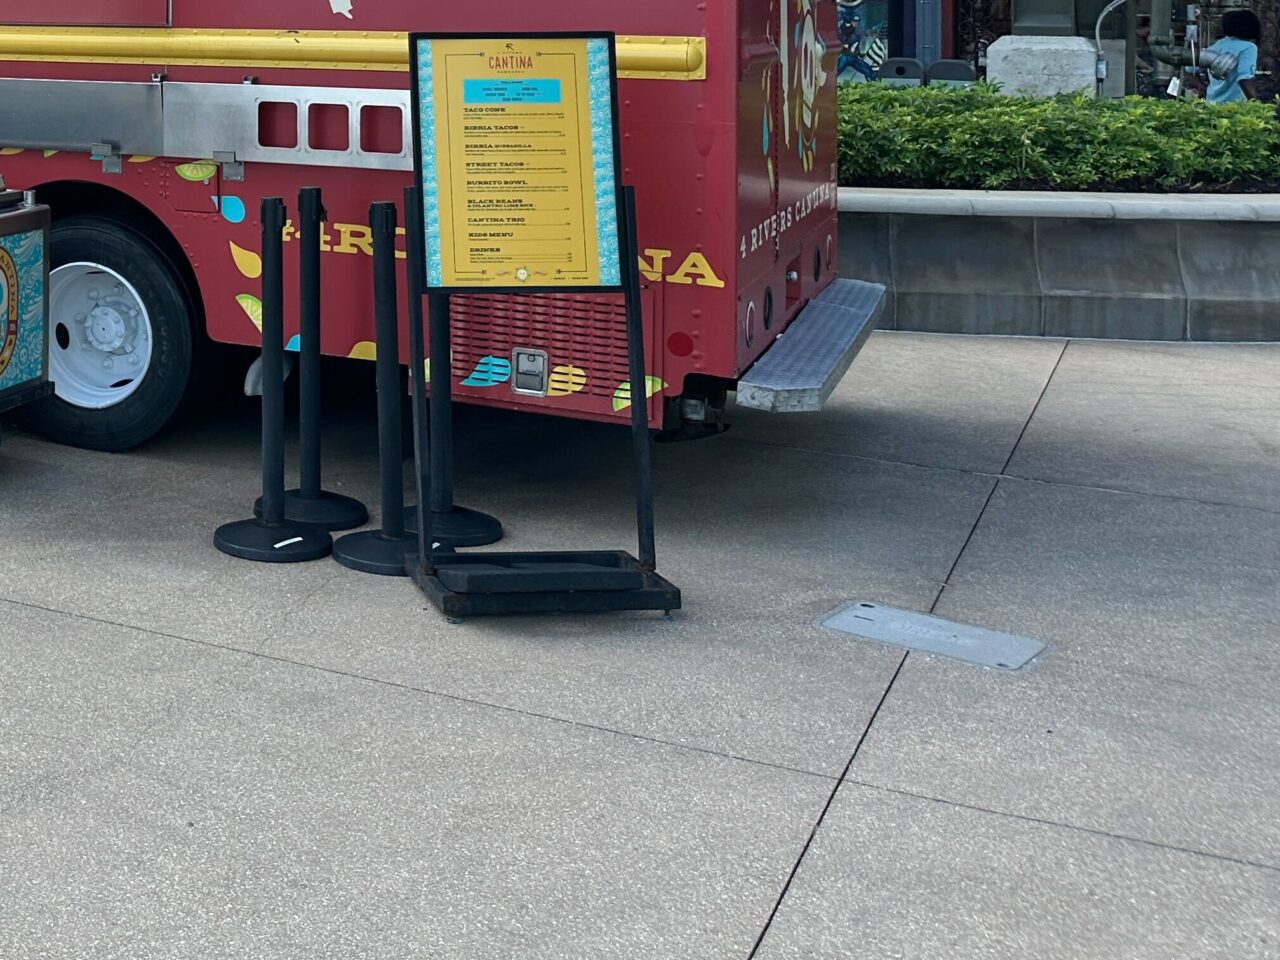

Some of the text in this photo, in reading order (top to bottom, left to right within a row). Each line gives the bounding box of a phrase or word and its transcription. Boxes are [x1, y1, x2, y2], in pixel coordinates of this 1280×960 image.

[488, 55, 534, 70] CANTINA
[739, 234, 747, 259] 4
[750, 206, 792, 252] RIVERS
[795, 182, 830, 222] CANTINA
